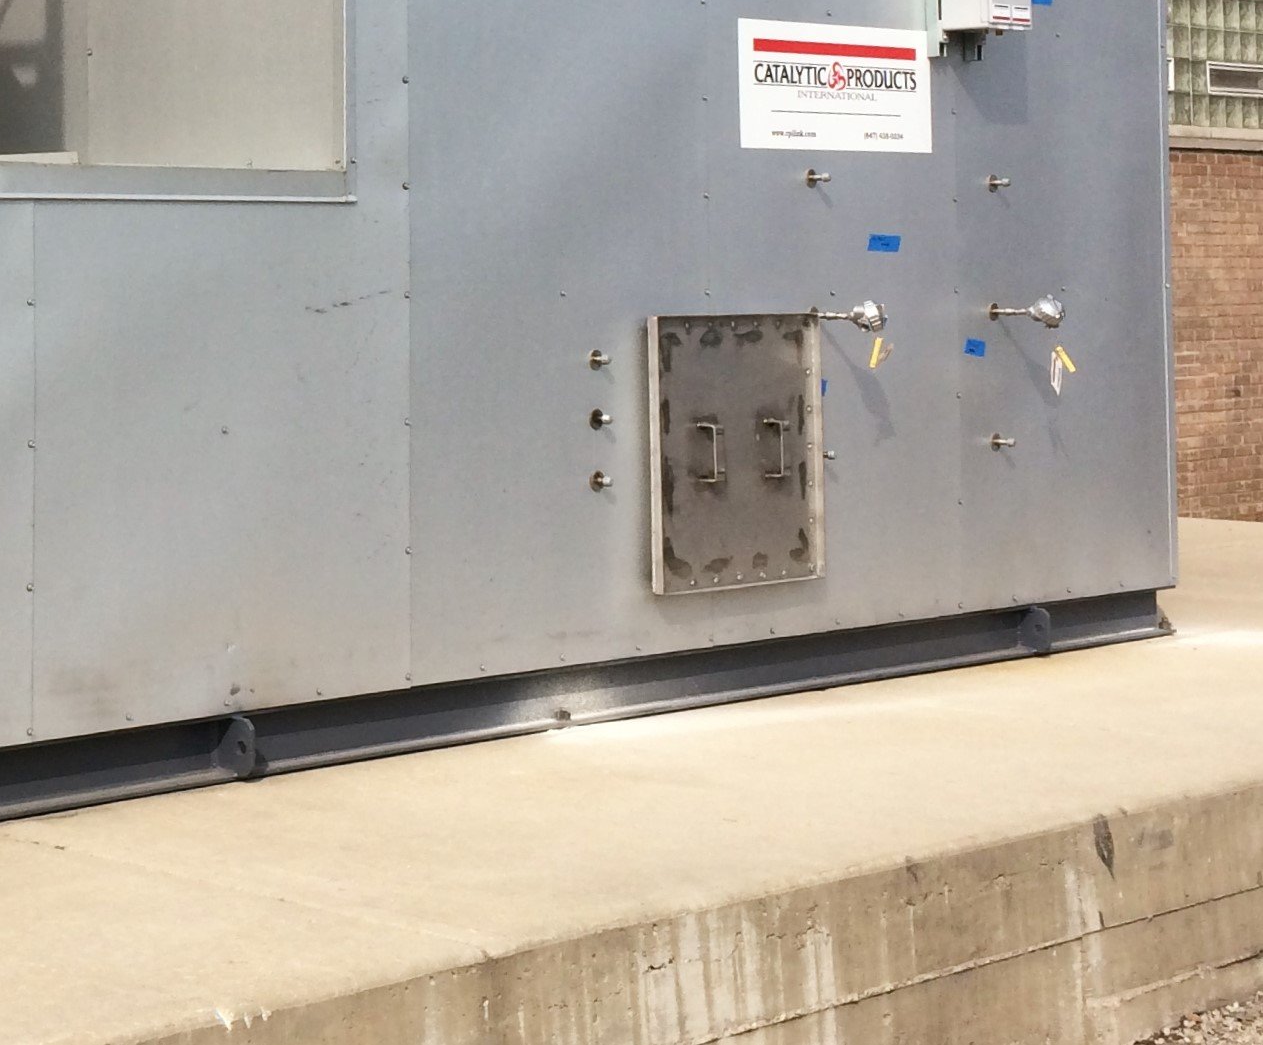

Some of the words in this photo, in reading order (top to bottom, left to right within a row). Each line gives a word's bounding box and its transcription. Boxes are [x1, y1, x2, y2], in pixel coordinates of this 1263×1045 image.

[754, 63, 826, 86] CATALYTIC
[846, 68, 917, 91] PRODUCTS
[797, 89, 878, 102] INTERNATIONAL
